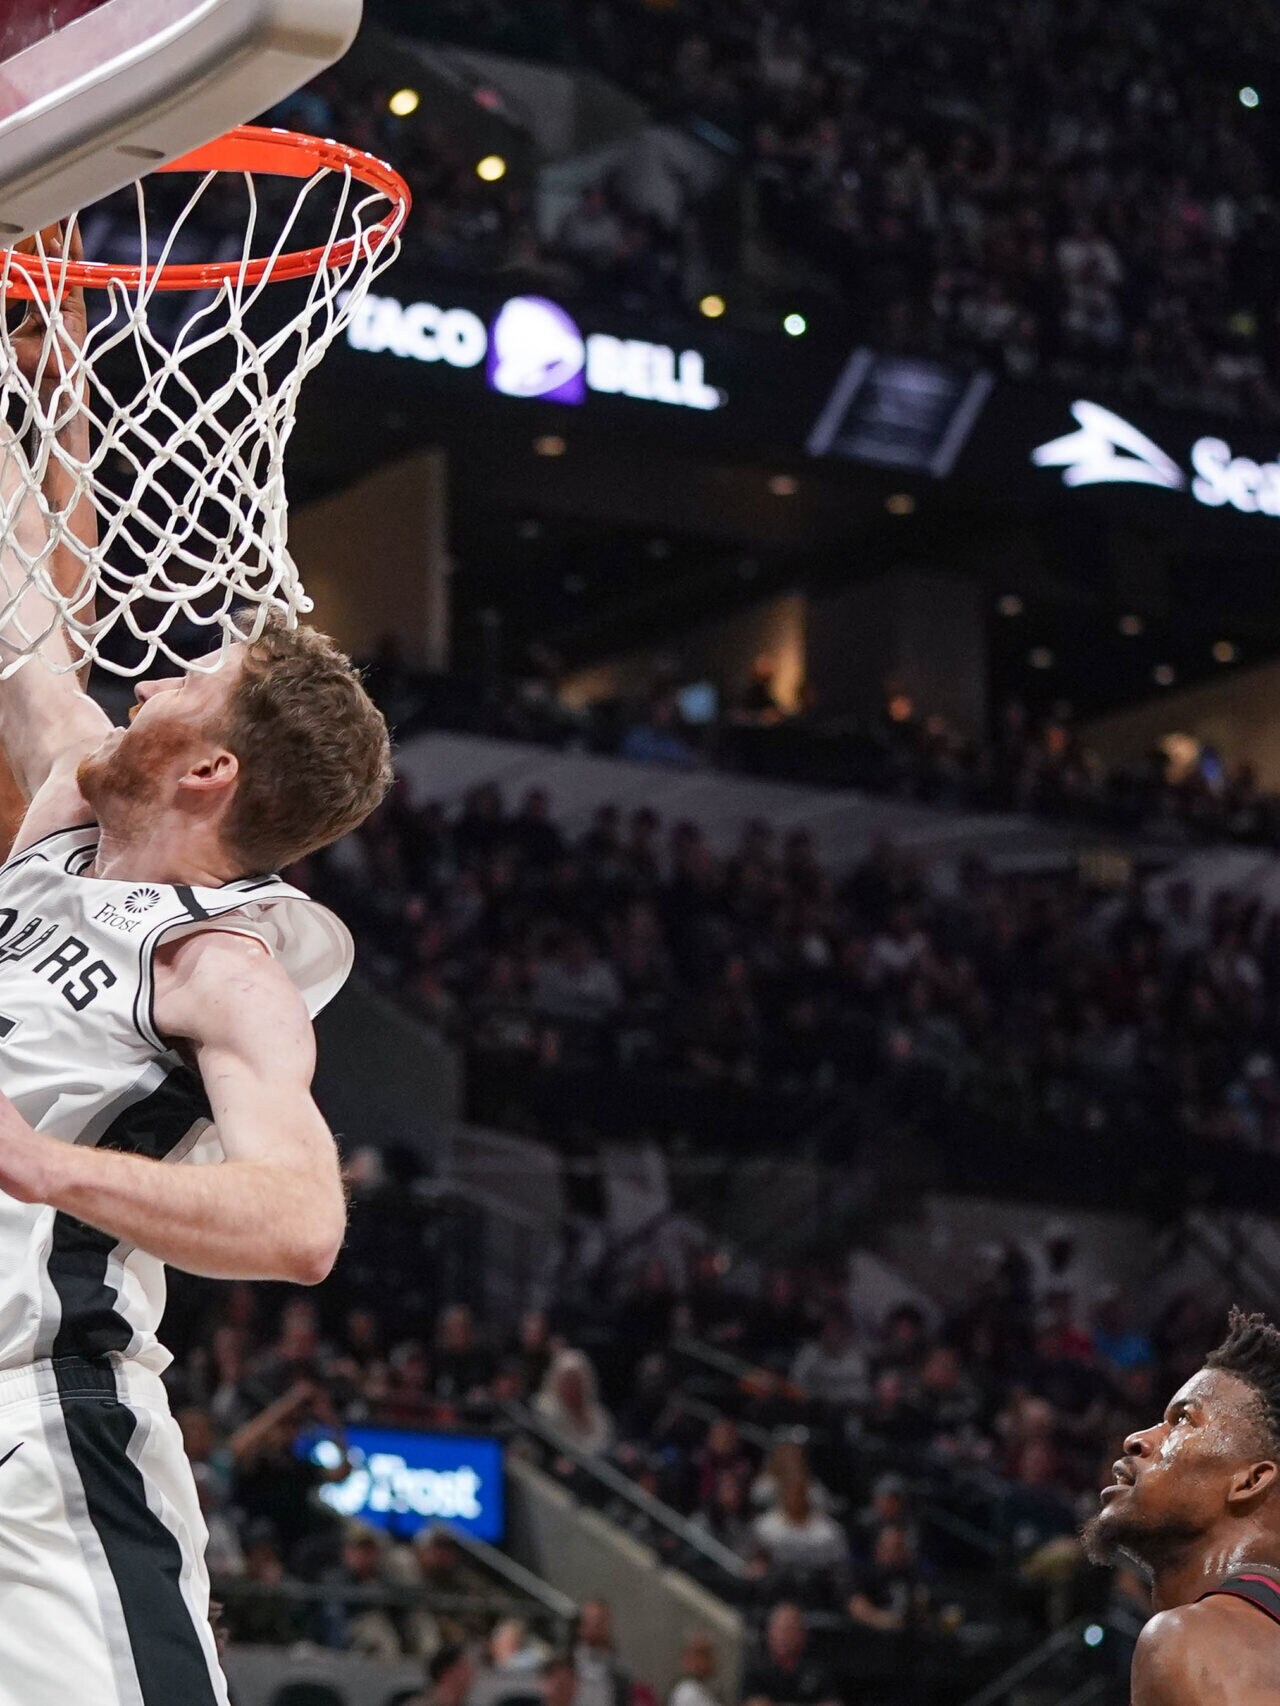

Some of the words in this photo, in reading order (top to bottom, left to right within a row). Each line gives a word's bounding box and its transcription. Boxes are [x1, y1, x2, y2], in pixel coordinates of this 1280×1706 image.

[336, 289, 487, 368] TACO
[585, 333, 722, 411] BELL
[92, 902, 143, 933] Frost
